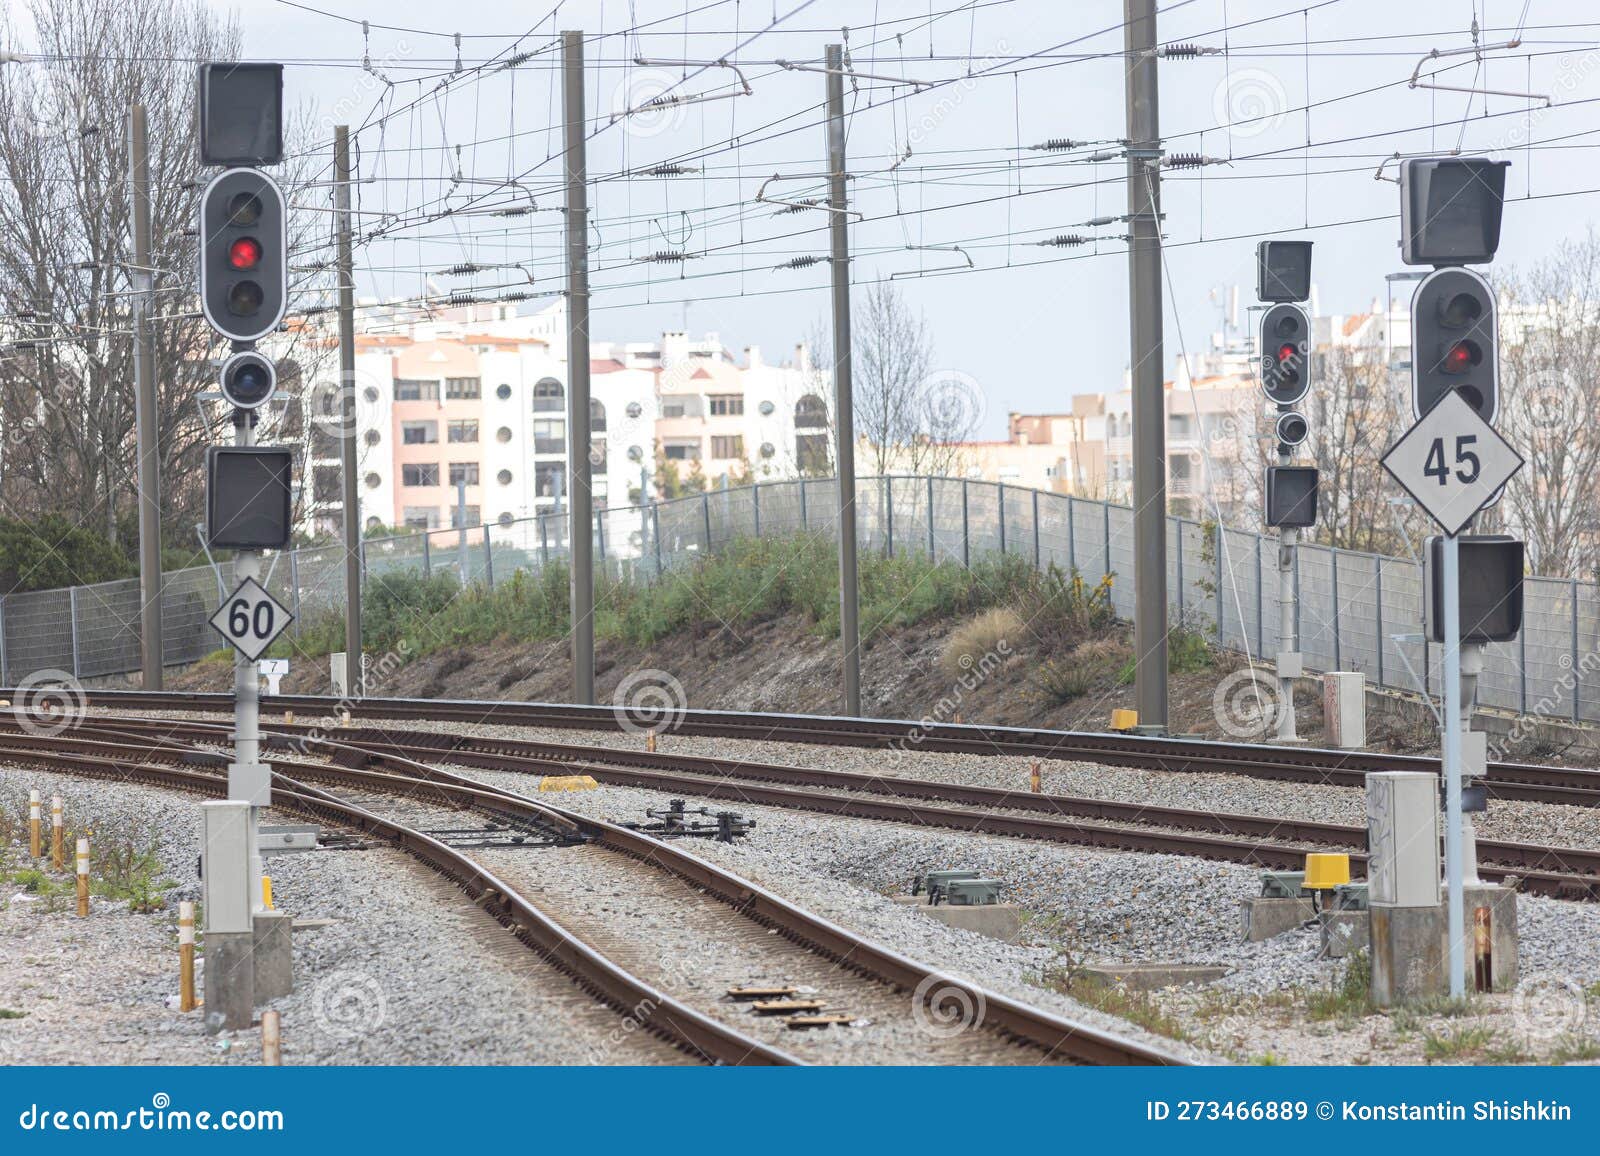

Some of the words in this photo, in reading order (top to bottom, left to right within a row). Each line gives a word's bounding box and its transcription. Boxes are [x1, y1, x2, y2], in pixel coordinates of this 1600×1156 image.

[1423, 434, 1481, 486] 45
[229, 598, 274, 639] 60
[270, 661, 278, 673] 7
